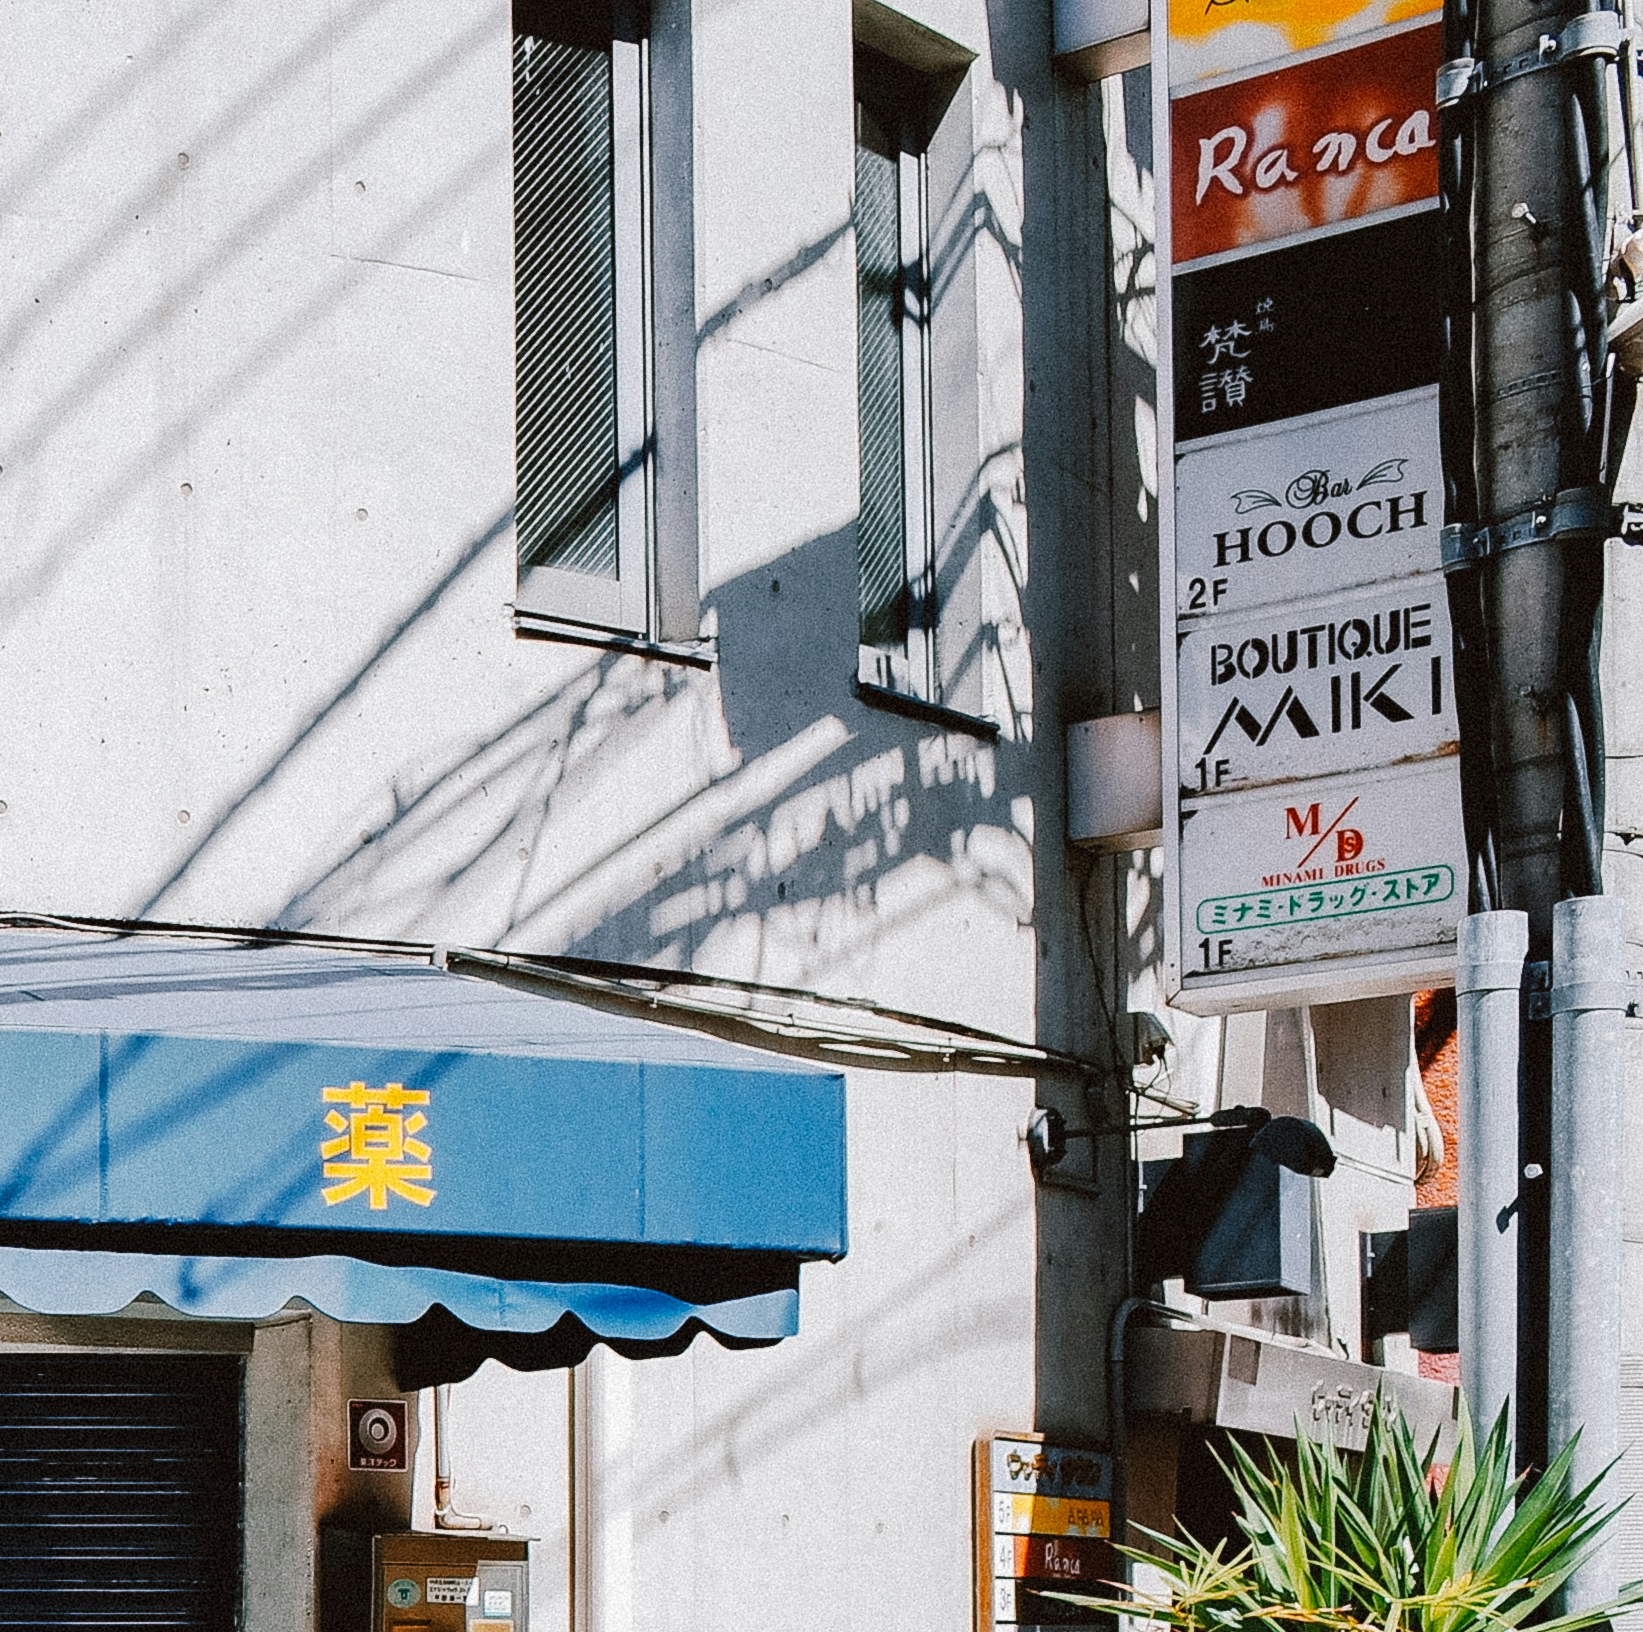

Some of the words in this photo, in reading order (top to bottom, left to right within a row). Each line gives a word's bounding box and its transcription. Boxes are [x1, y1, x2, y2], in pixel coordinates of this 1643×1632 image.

[1195, 109, 1437, 206] Ranca
[1285, 469, 1353, 510] Bar
[1213, 490, 1428, 568] HOOCH
[1188, 577, 1228, 611] 2F
[1211, 602, 1432, 686] BOUTIQUE
[1203, 656, 1442, 755] MIKI
[1194, 757, 1230, 791] 1F
[1261, 867, 1324, 887] MINAMI
[1334, 858, 1386, 877] DRUGS
[1198, 937, 1233, 969] 1F
[320, 1080, 438, 1210] 薬
